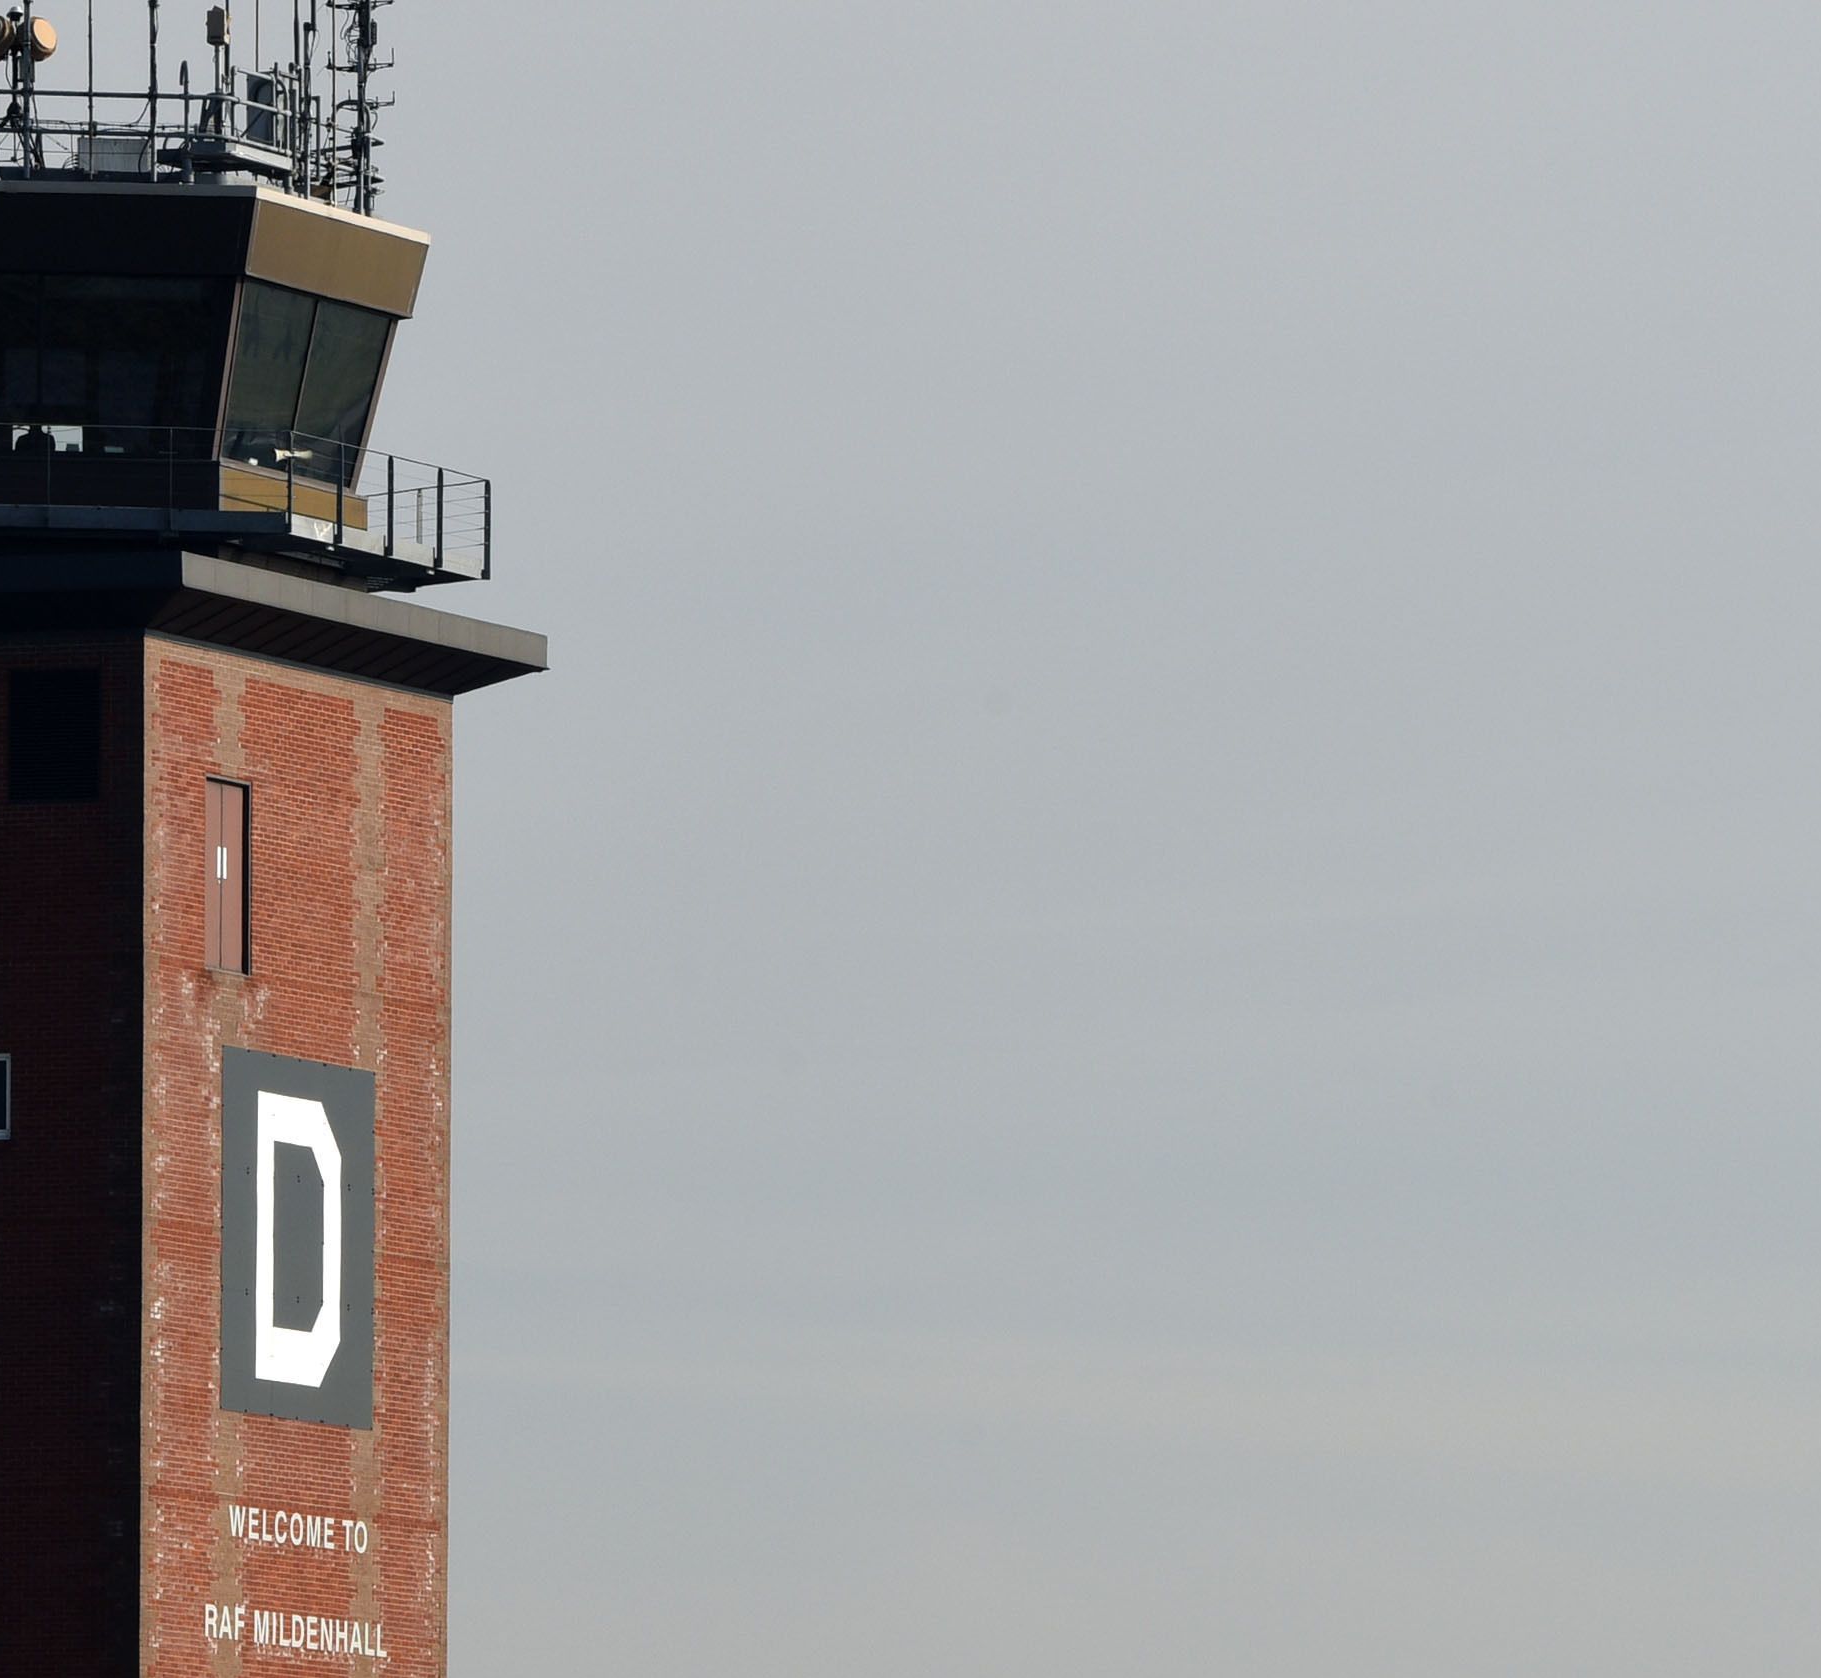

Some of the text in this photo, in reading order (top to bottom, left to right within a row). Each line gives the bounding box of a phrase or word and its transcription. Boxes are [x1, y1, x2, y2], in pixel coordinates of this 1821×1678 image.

[255, 1090, 342, 1388] D
[229, 1504, 369, 1554] WELCOME TO
[204, 1603, 387, 1658] RAF MILDENHALL
